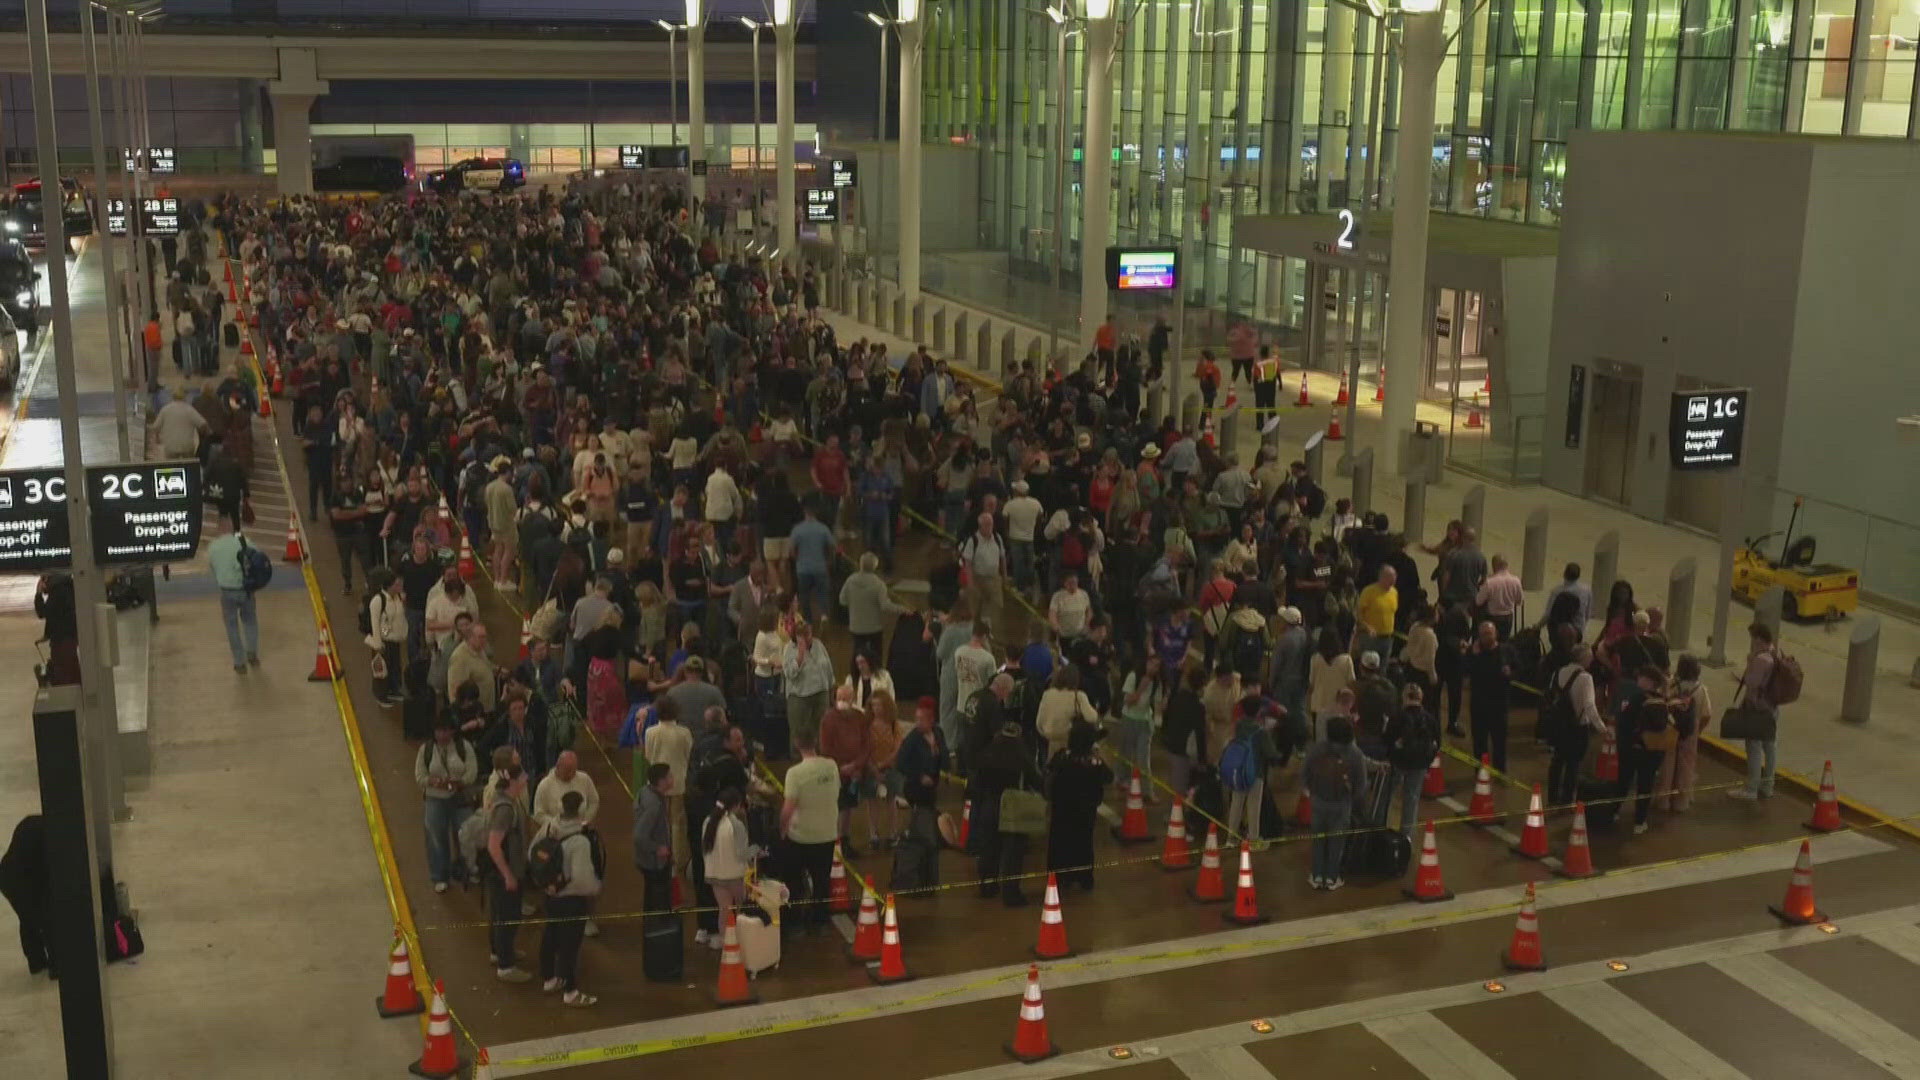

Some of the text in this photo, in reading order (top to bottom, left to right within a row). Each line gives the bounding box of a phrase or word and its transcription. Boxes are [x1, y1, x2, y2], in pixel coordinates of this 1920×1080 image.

[150, 149, 163, 158] 2A
[632, 146, 643, 155] 1A
[821, 191, 835, 202] 1B
[144, 200, 161, 212] 2B
[1337, 208, 1353, 249] 2
[1713, 396, 1739, 418] 1C
[1686, 429, 1724, 439] Passenger
[1684, 439, 1718, 451] Drop-Off
[24, 477, 67, 504] 3C
[102, 473, 144, 499] 2C
[124, 510, 188, 525] Passenger
[135, 521, 189, 538] Drop-Off
